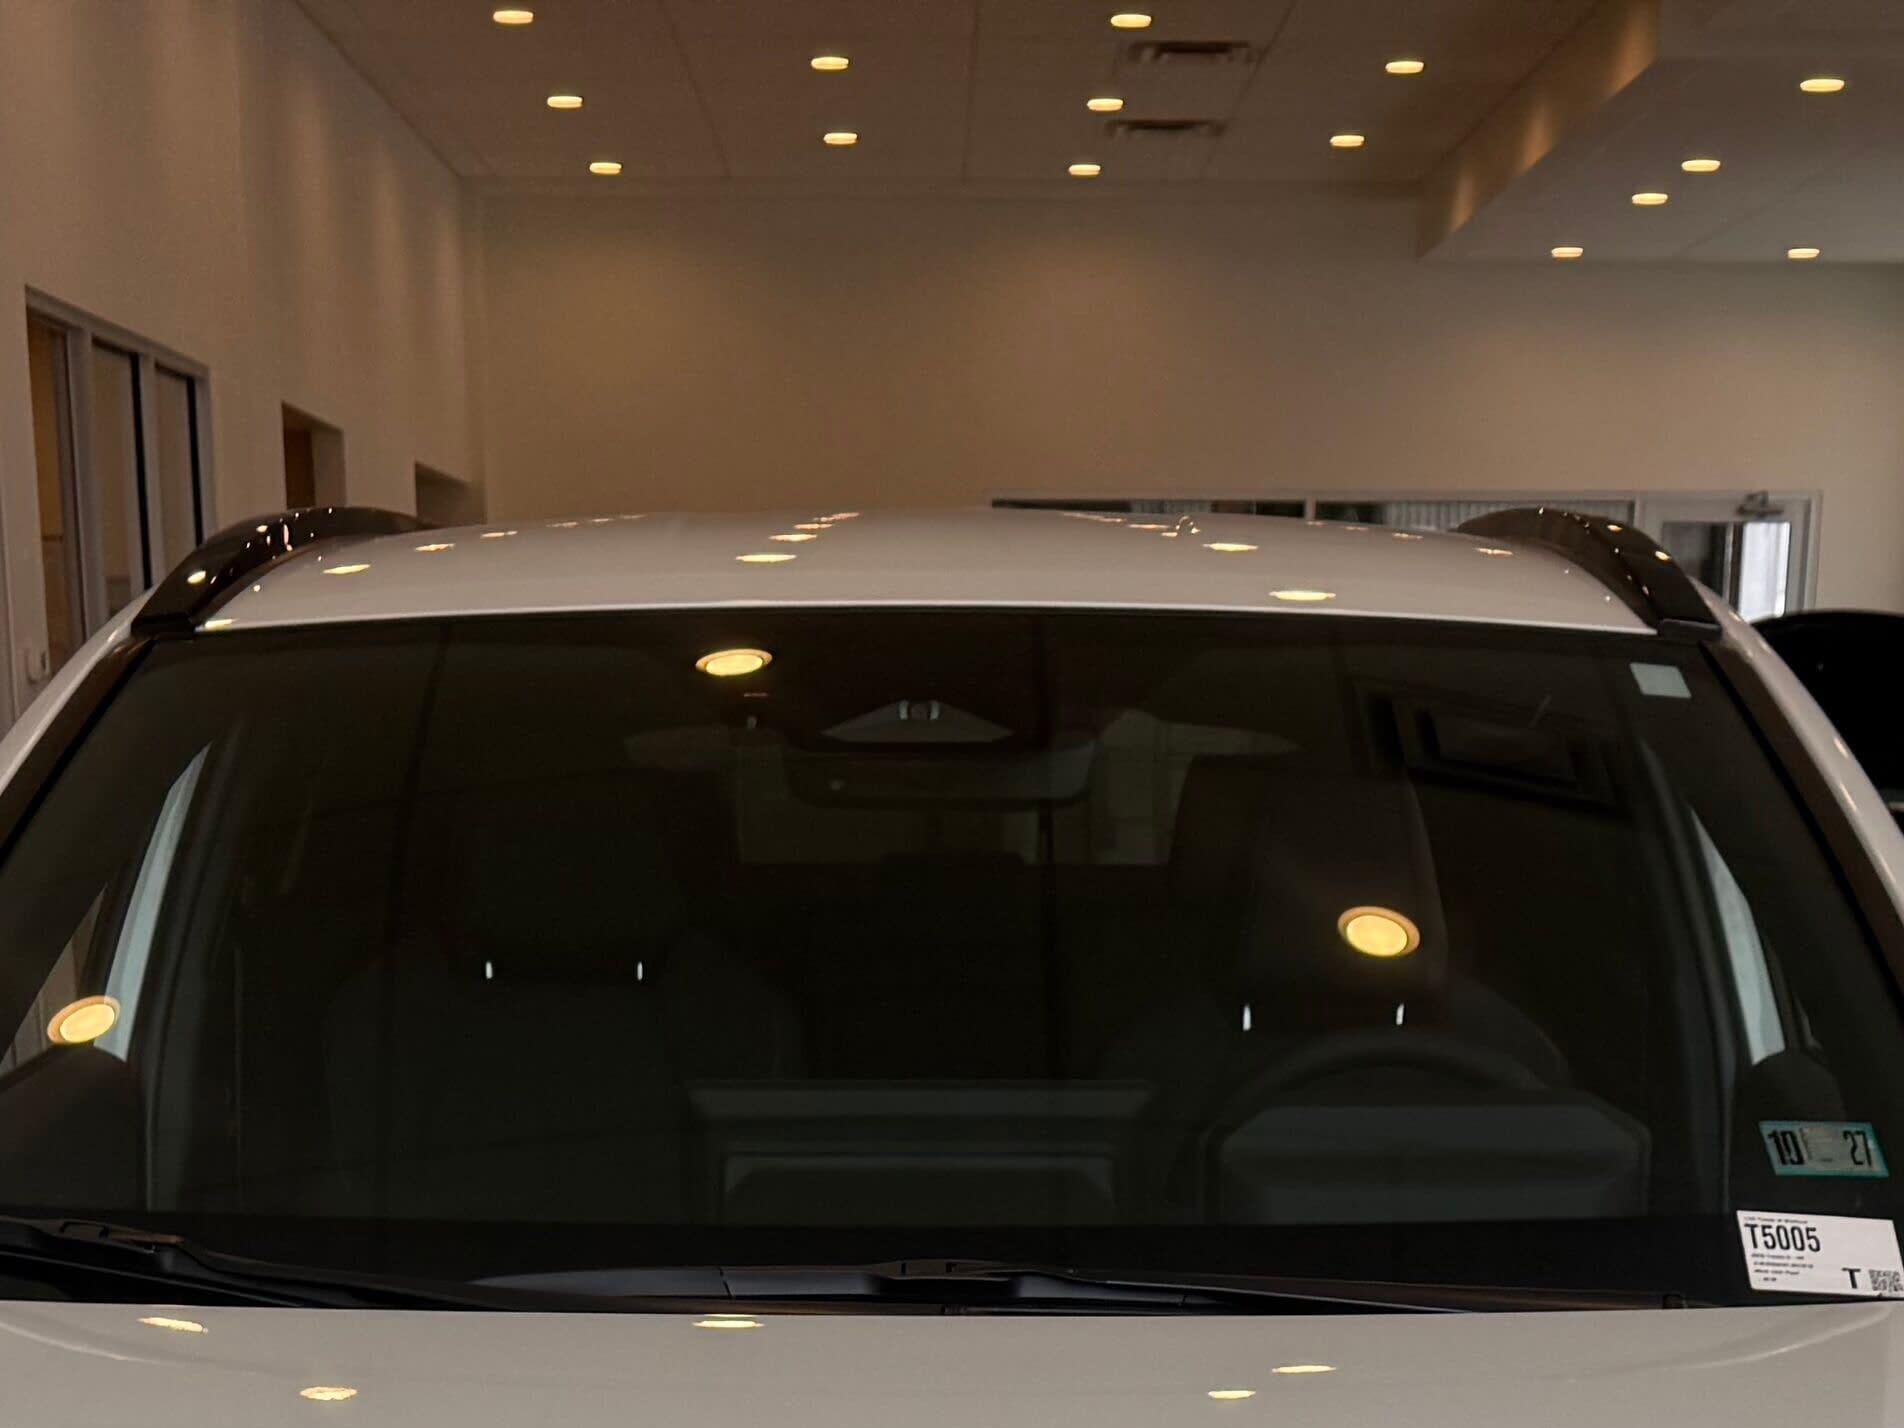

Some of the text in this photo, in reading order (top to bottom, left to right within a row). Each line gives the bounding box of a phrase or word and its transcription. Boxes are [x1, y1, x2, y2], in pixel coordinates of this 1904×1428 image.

[1767, 1129, 1873, 1168] 10 27
[1743, 1222, 1821, 1253] T5005
[1841, 1267, 1862, 1289] T
